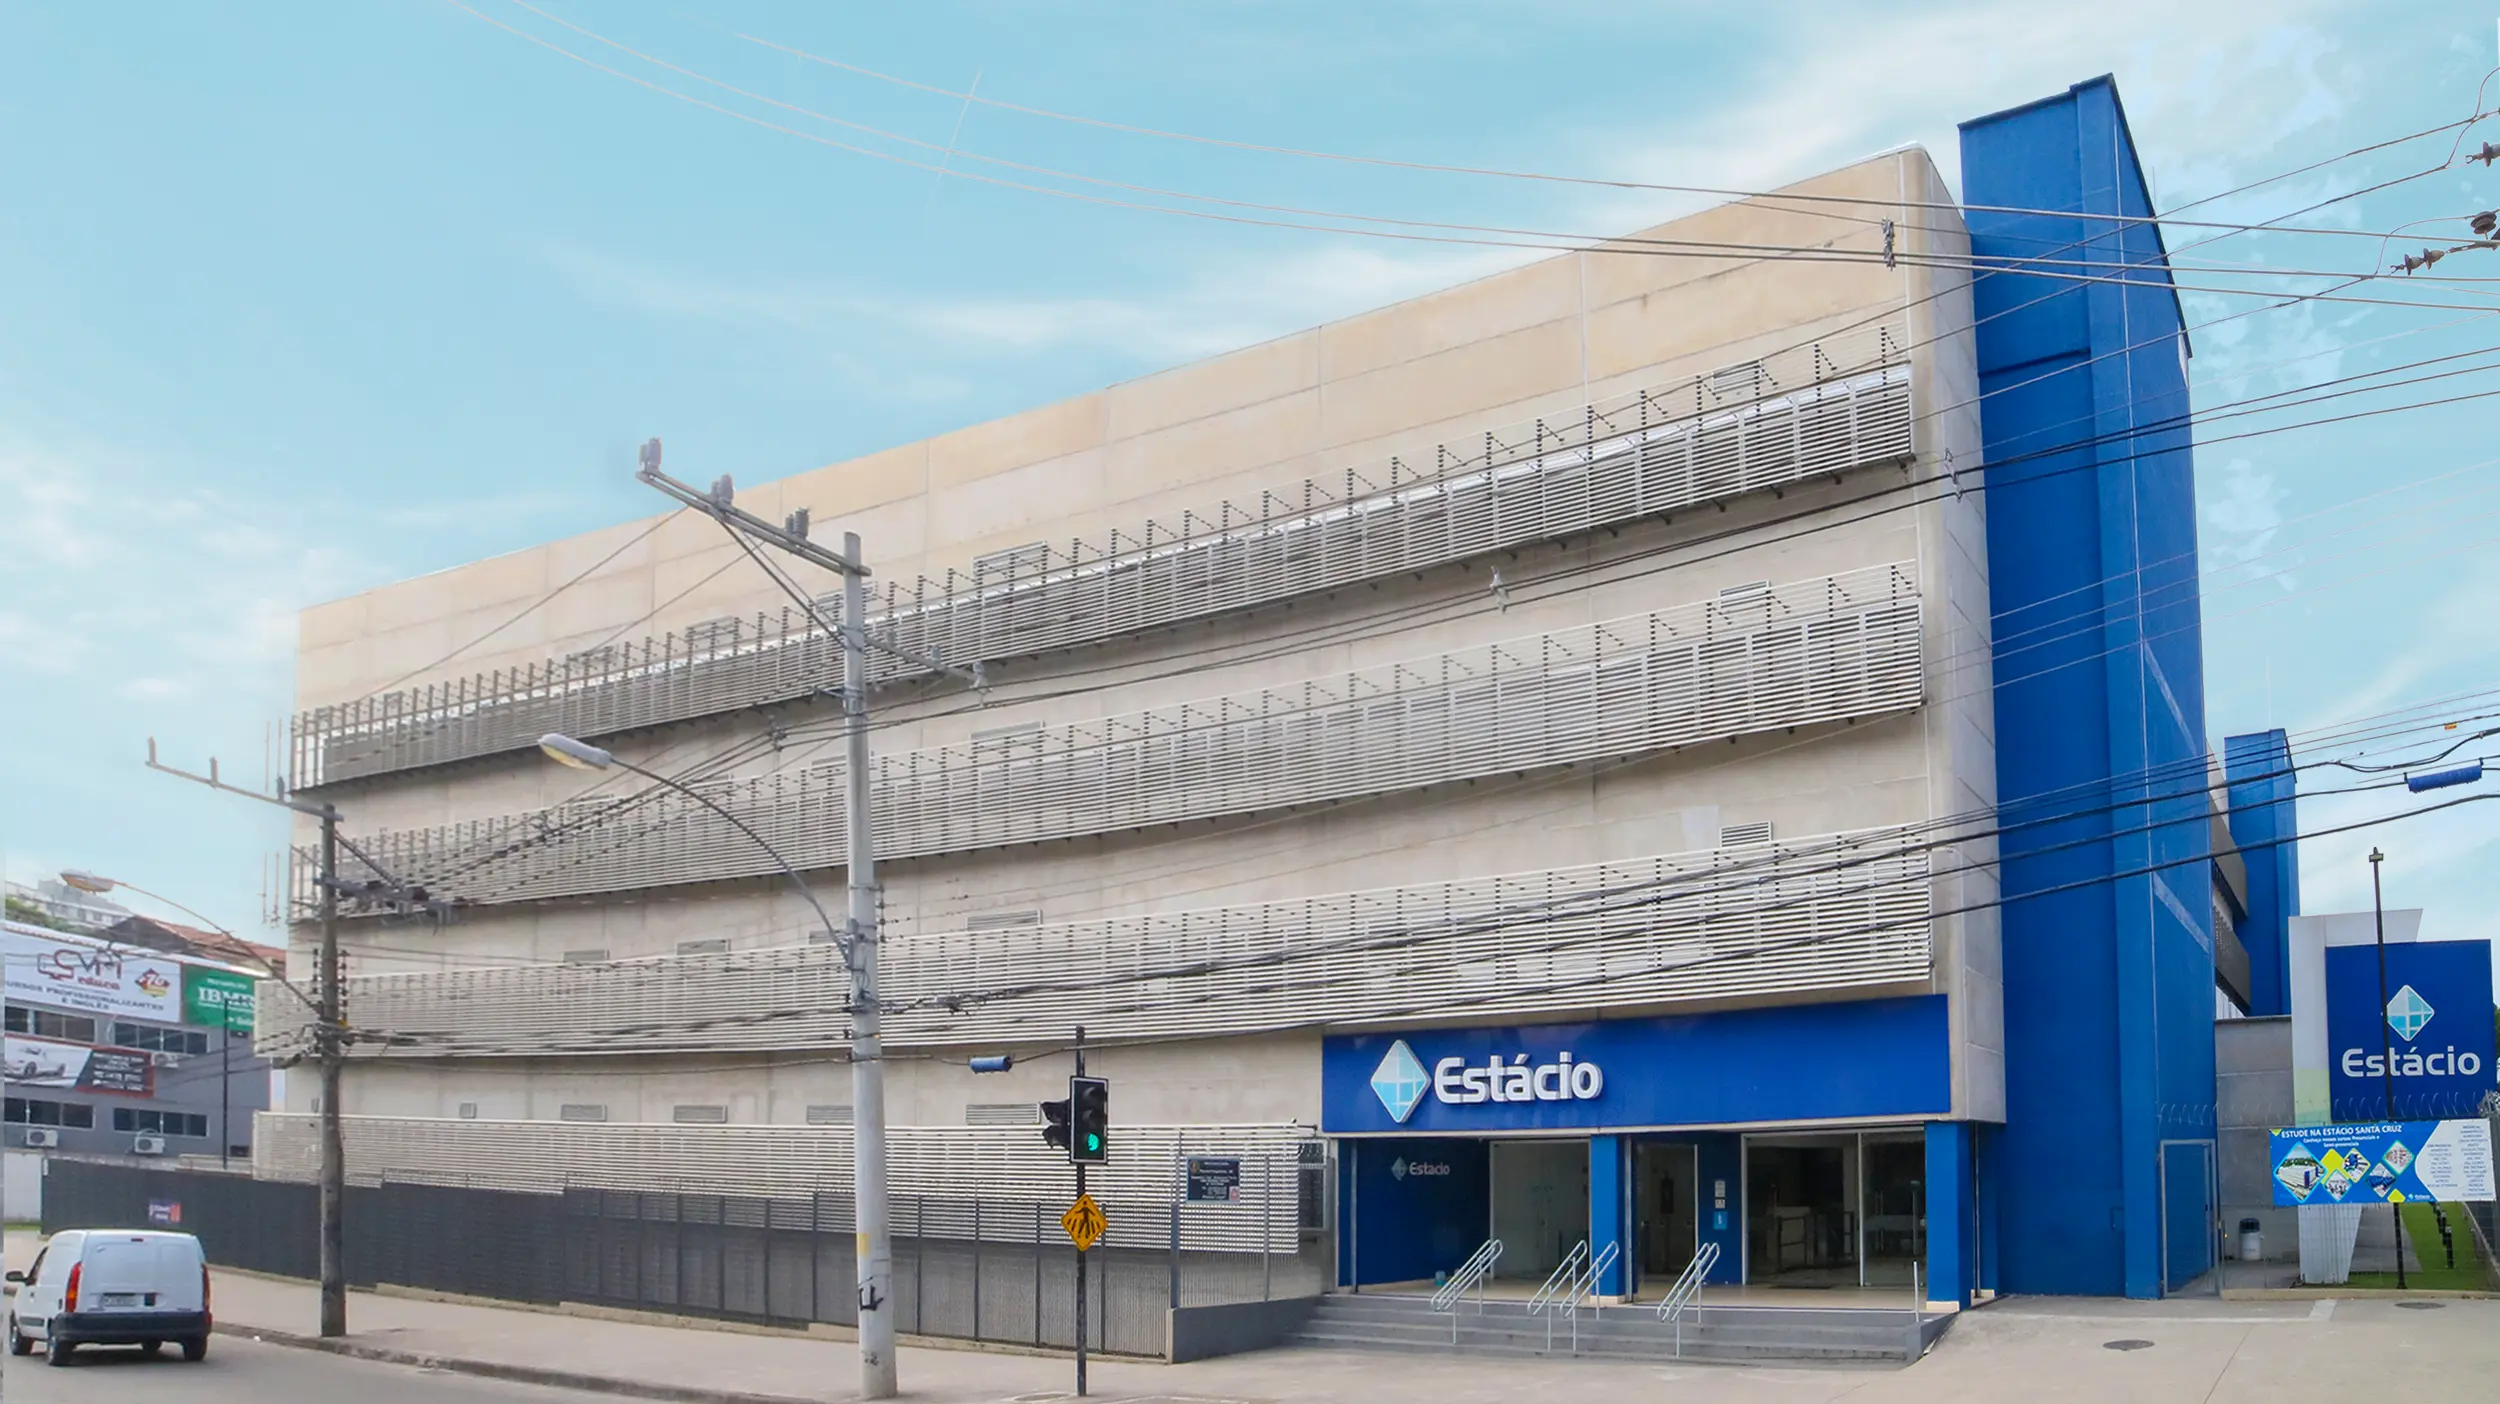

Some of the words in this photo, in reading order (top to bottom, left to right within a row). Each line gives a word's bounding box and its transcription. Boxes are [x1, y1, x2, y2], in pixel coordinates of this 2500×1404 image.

[46, 987, 165, 1011] PROFISSIONALIZANTES
[2341, 1045, 2481, 1078] Estácio
[1434, 1051, 1603, 1104] Estácio
[2281, 1129, 2308, 1139] ESTUDE
[2310, 1128, 2321, 1137] NA
[2355, 1125, 2381, 1134] SANTA
[2381, 1124, 2402, 1133] CRUZ
